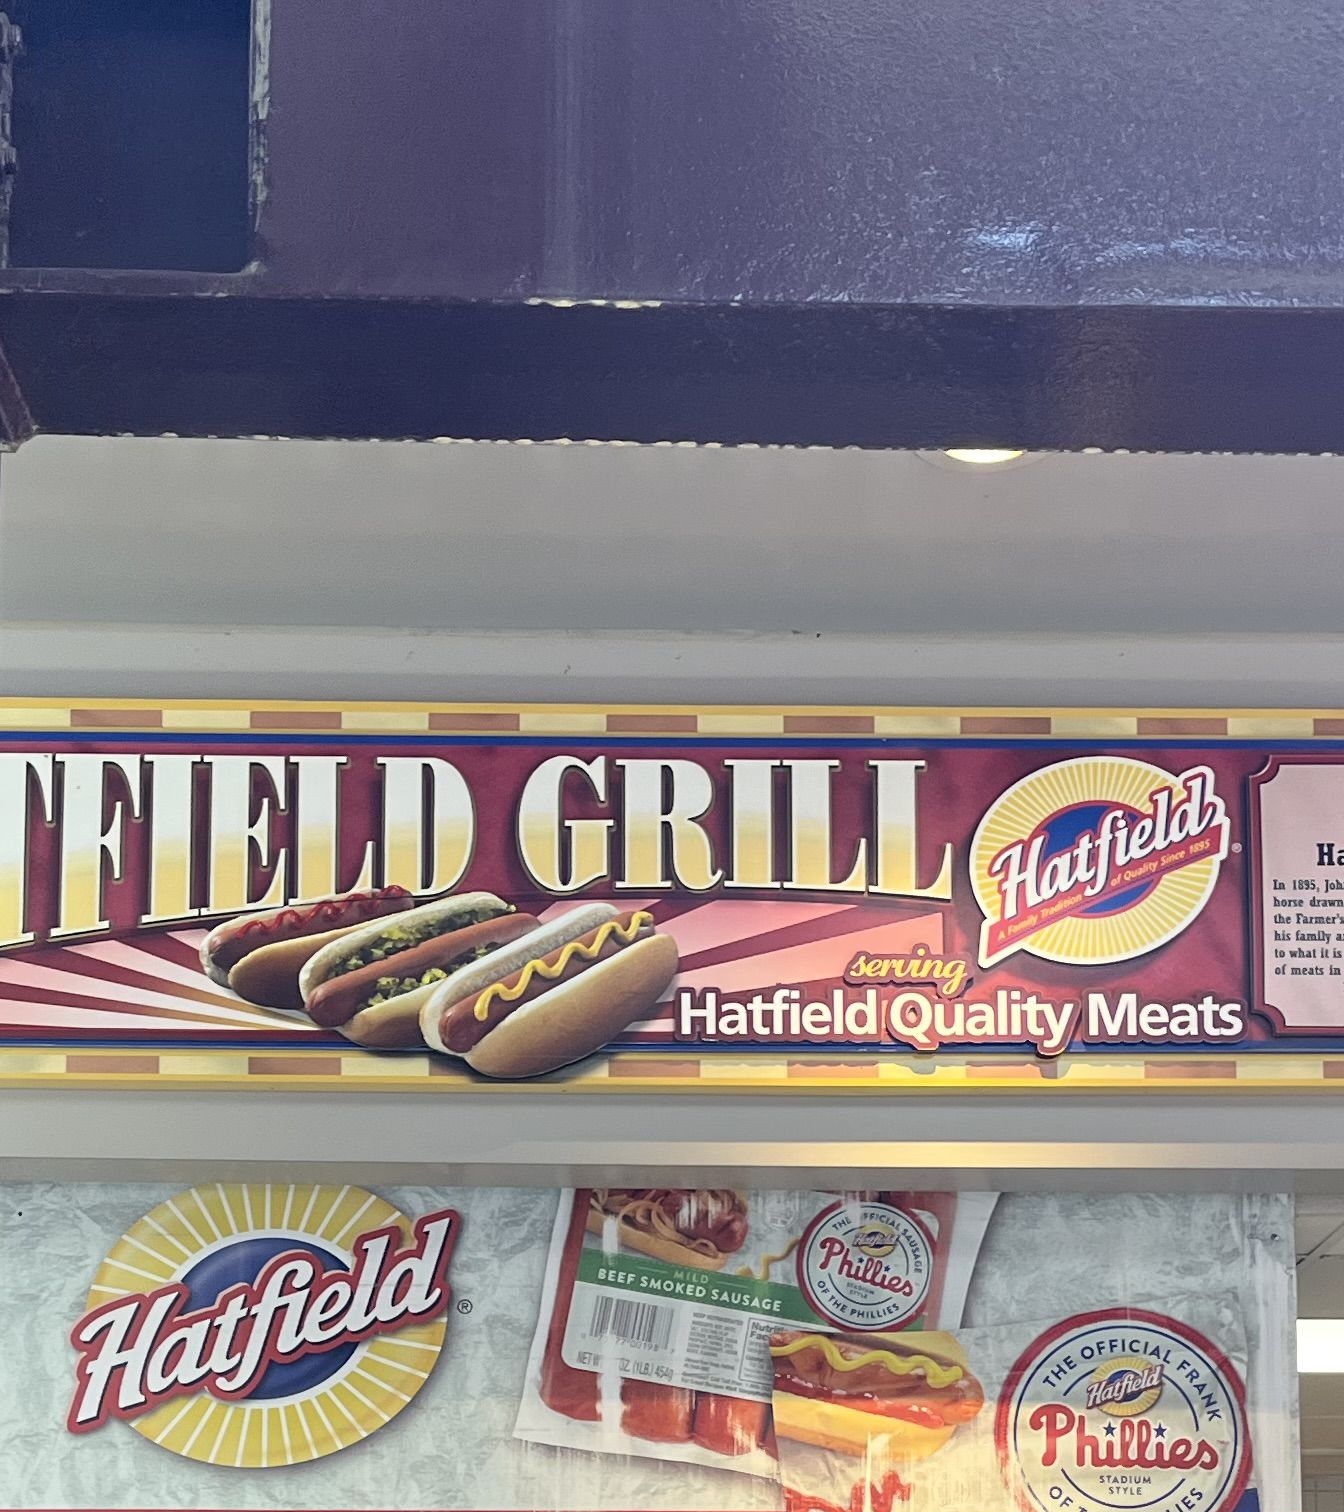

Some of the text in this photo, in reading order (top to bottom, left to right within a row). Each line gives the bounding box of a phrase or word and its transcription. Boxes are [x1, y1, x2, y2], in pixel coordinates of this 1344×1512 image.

[518, 754, 953, 901] GRILL
[991, 777, 1216, 919] Hatfield
[1111, 839, 1210, 886] of Quality Since 1895
[1273, 880, 1285, 890] In
[1292, 880, 1320, 892] 1895,
[1273, 896, 1303, 907] horse
[1310, 897, 1343, 907] drawn
[997, 894, 1082, 940] A Family Tradition
[1274, 914, 1291, 924] the
[1296, 914, 1344, 924] Farmer's
[1275, 931, 1291, 941] his
[1296, 931, 1331, 944] family
[850, 948, 967, 995] serving
[1275, 949, 1285, 958] to
[1289, 948, 1316, 958] what
[1320, 948, 1329, 958] it
[1333, 948, 1342, 958] is
[1275, 965, 1286, 975] of
[1291, 966, 1324, 975] meats
[1329, 965, 1341, 975] in
[680, 990, 1243, 1048] Hatfield Quality Meats
[832, 1216, 852, 1231] THE
[901, 1228, 922, 1274] SAUSAGE
[673, 1270, 709, 1283] MILD
[819, 1237, 913, 1297] Phillies
[598, 1268, 781, 1312] BEEF SMOKED SAUSAGE
[817, 1280, 829, 1296] OF
[828, 1296, 848, 1314] THE
[850, 1303, 900, 1319] PHILLIES
[73, 1215, 453, 1425] Hatfield
[1043, 1339, 1222, 1422] THE OFFICIAL FRANK
[1087, 1366, 1162, 1408] Hatfield
[1029, 1404, 1219, 1470] Phillies
[1049, 1486, 1073, 1510] OF
[1099, 1475, 1151, 1484] STADIUM
[1108, 1486, 1143, 1496] STYLE
